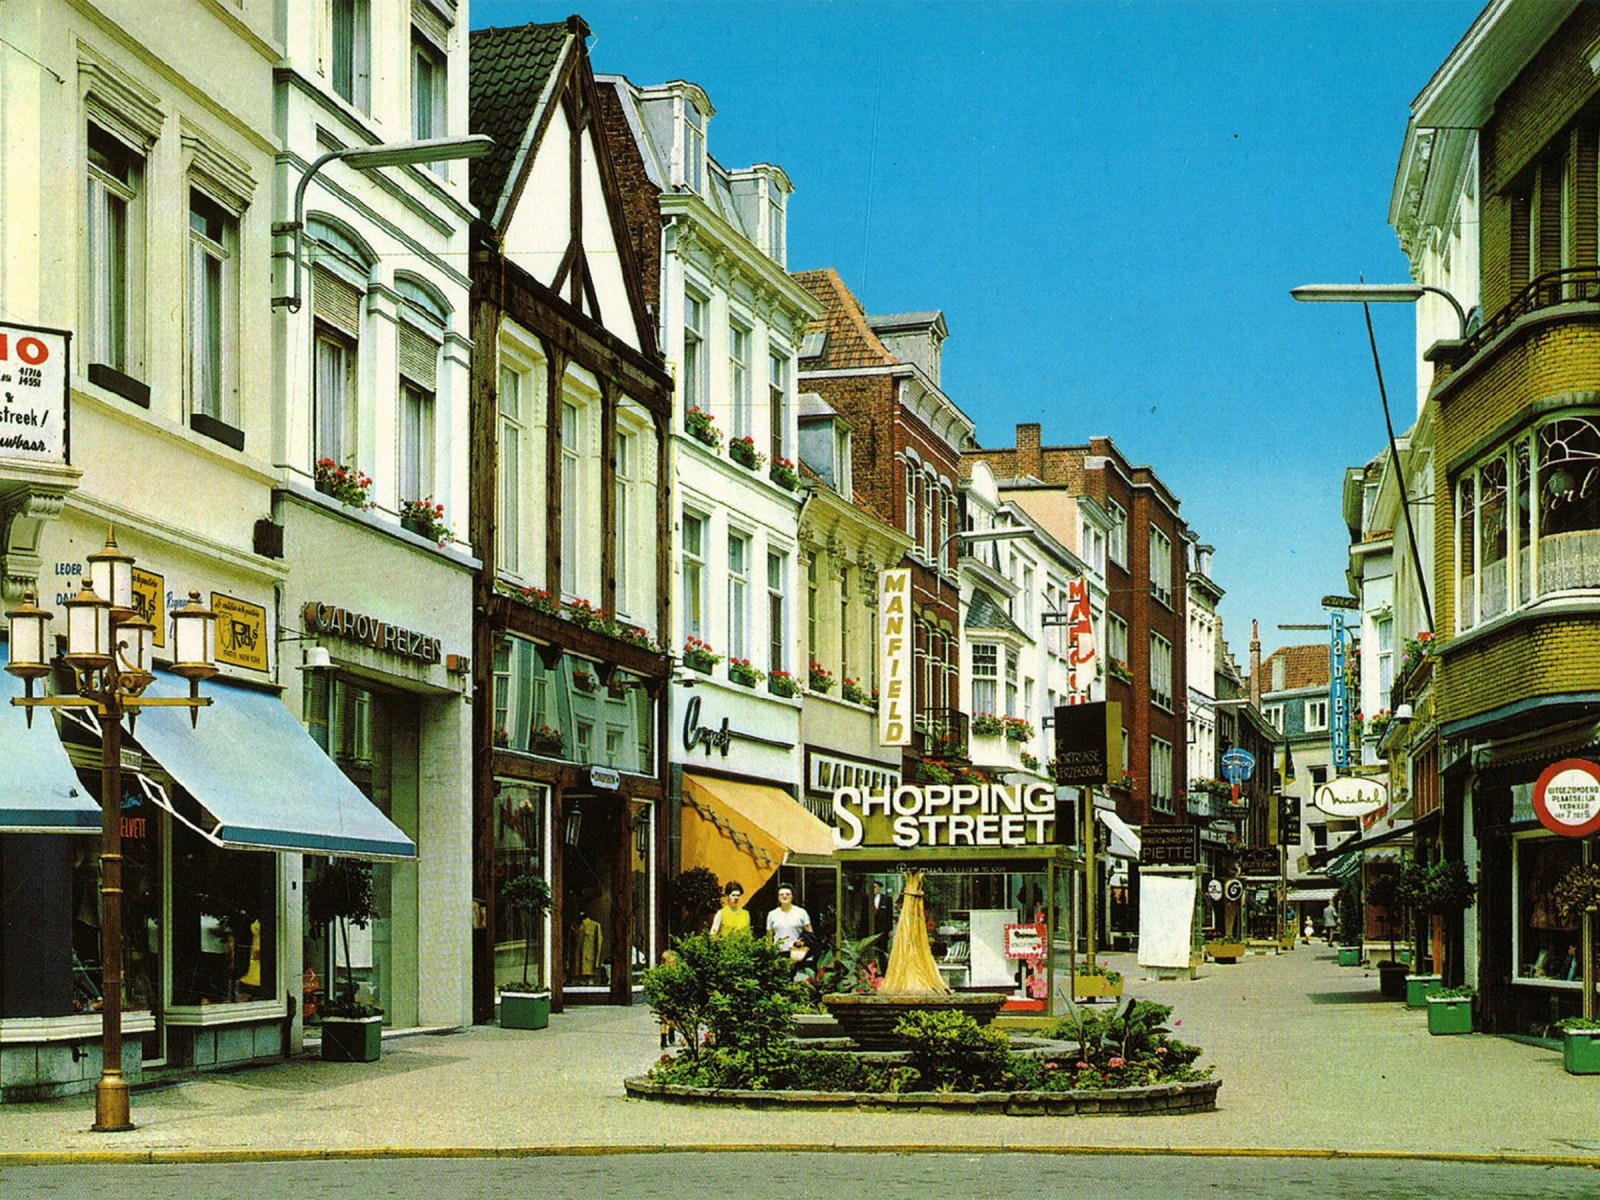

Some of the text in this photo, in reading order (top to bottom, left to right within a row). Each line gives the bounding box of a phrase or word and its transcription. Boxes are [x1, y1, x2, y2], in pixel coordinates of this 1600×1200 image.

[55, 562, 82, 576] LEDER
[384, 620, 442, 664] REIZEN
[884, 574, 906, 742] MANFIELD
[832, 782, 1055, 849] SHOPPING
[892, 814, 1055, 847] STREET
[1143, 846, 1193, 859] PIETTE
